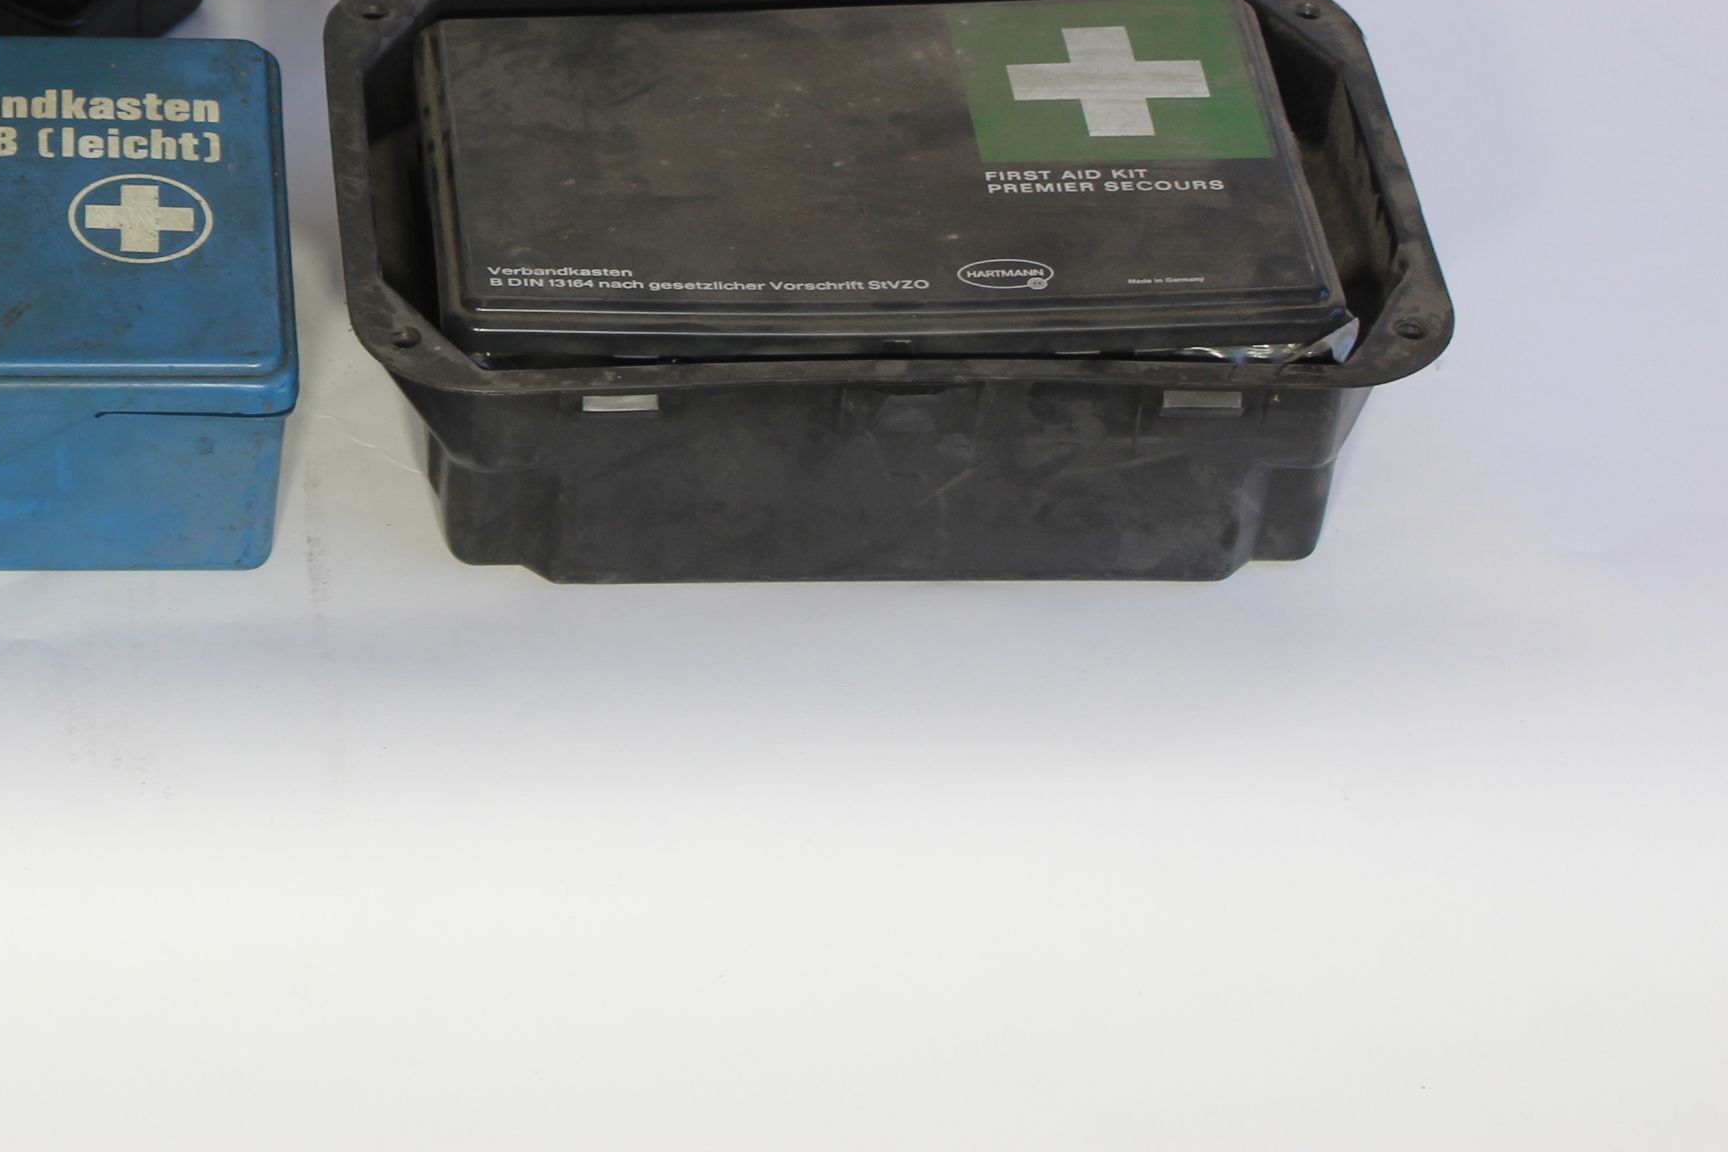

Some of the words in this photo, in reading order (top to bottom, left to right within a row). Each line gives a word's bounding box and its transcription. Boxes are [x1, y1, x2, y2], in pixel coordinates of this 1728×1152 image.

[985, 170, 1052, 182] FIRST
[1060, 169, 1102, 181] AID
[1111, 168, 1148, 179] KIT
[988, 182, 1095, 194] PREMIER
[1104, 179, 1225, 192] SECOURS
[487, 266, 633, 278] Verbandkasten
[966, 268, 1045, 279] HARTMANN
[490, 278, 503, 287] B
[507, 278, 544, 288] DIN
[549, 278, 593, 289] 13164
[598, 279, 644, 290] nach
[649, 280, 765, 292] gesetzlicher
[769, 280, 865, 291] Vorschrift
[868, 279, 930, 290] StVZO
[1165, 276, 1205, 284] Germany
